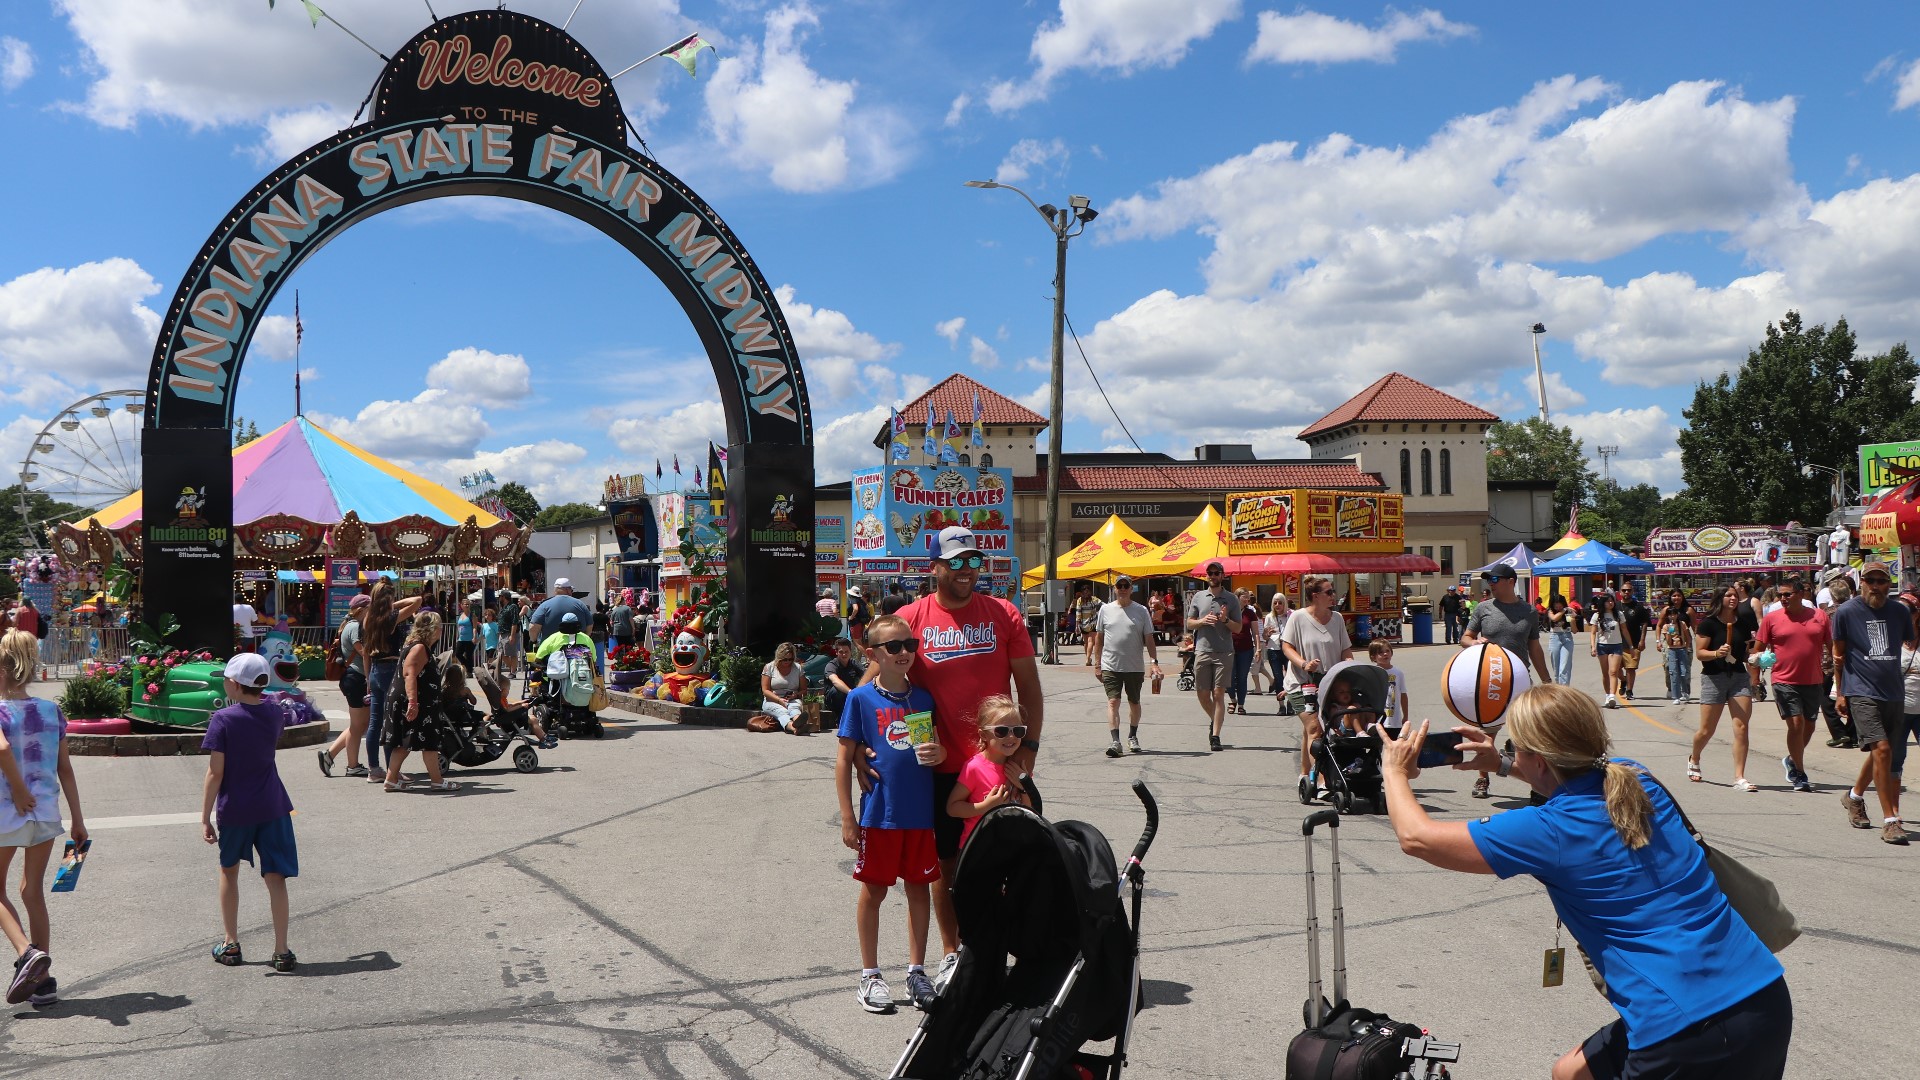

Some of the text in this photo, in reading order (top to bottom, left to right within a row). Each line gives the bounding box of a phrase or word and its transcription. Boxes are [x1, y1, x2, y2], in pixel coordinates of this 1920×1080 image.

[416, 34, 603, 107] Welcome
[460, 106, 538, 126] TO THE
[168, 116, 797, 423] INDIANA STATE FAIR MIDWAY
[855, 474, 880, 485] ICE CREAM
[894, 486, 1004, 507] FUNNEL CAKES
[1075, 504, 1161, 516] AGRICULTURE
[1240, 501, 1258, 513] HOT
[1343, 500, 1355, 510] HOT
[961, 512, 971, 527] &
[1235, 504, 1281, 524] WISCONSIN
[1340, 506, 1372, 522] WISCONSIN
[1248, 515, 1277, 531] CHEESE
[1350, 516, 1370, 529] CHEESE
[1866, 517, 1892, 530] DAIQUIRI
[150, 526, 227, 541] Indiana 811
[751, 528, 795, 542] Indiana
[795, 530, 811, 542] 811
[854, 538, 870, 549] FUNNEL
[976, 534, 1007, 550] EAM
[1653, 541, 1688, 552] CAKES
[815, 553, 837, 561] KETS
[1710, 559, 1751, 567] ELEPHANT
[866, 562, 875, 570] ICE
[876, 562, 898, 570] CREAM
[922, 621, 995, 650] Plainfield
[1487, 656, 1503, 701] TEXAS
